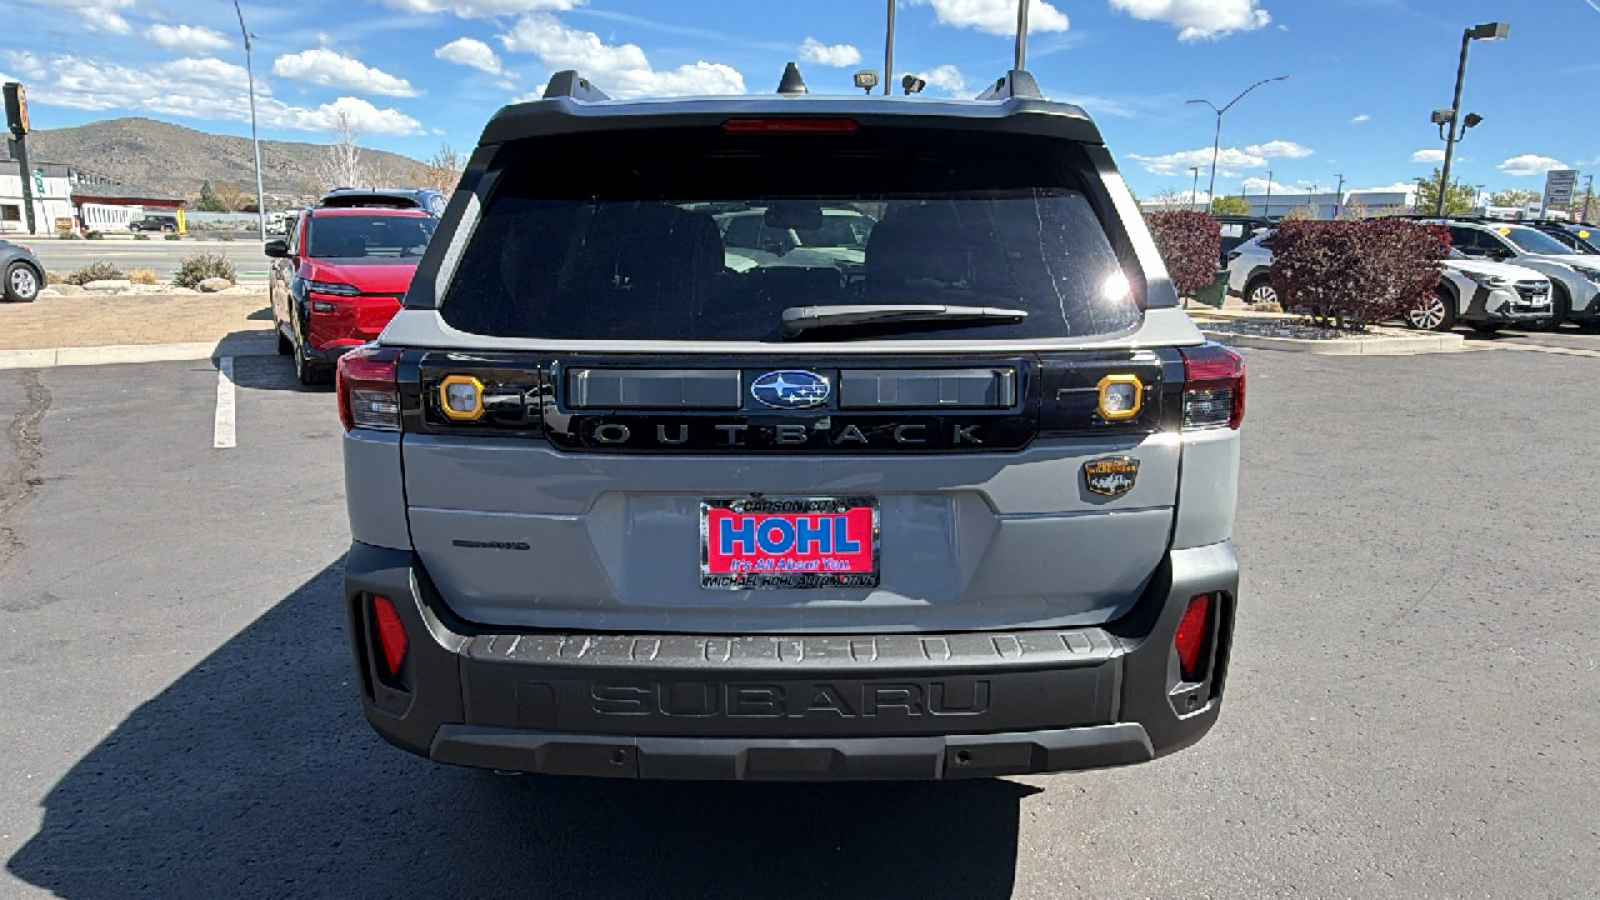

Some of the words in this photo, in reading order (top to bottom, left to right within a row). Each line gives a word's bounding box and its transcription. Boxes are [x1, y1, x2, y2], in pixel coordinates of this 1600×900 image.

[593, 423, 984, 446] OUTBACK
[744, 500, 803, 512] CARSON
[719, 517, 861, 555] HOHL
[730, 558, 752, 571] It's
[754, 558, 775, 571] All
[776, 558, 820, 571] About
[703, 575, 758, 587] MICHAEL
[762, 575, 795, 587] HOHL
[799, 575, 877, 587] AUTOMOTIVE
[591, 680, 990, 719] SUBARU
